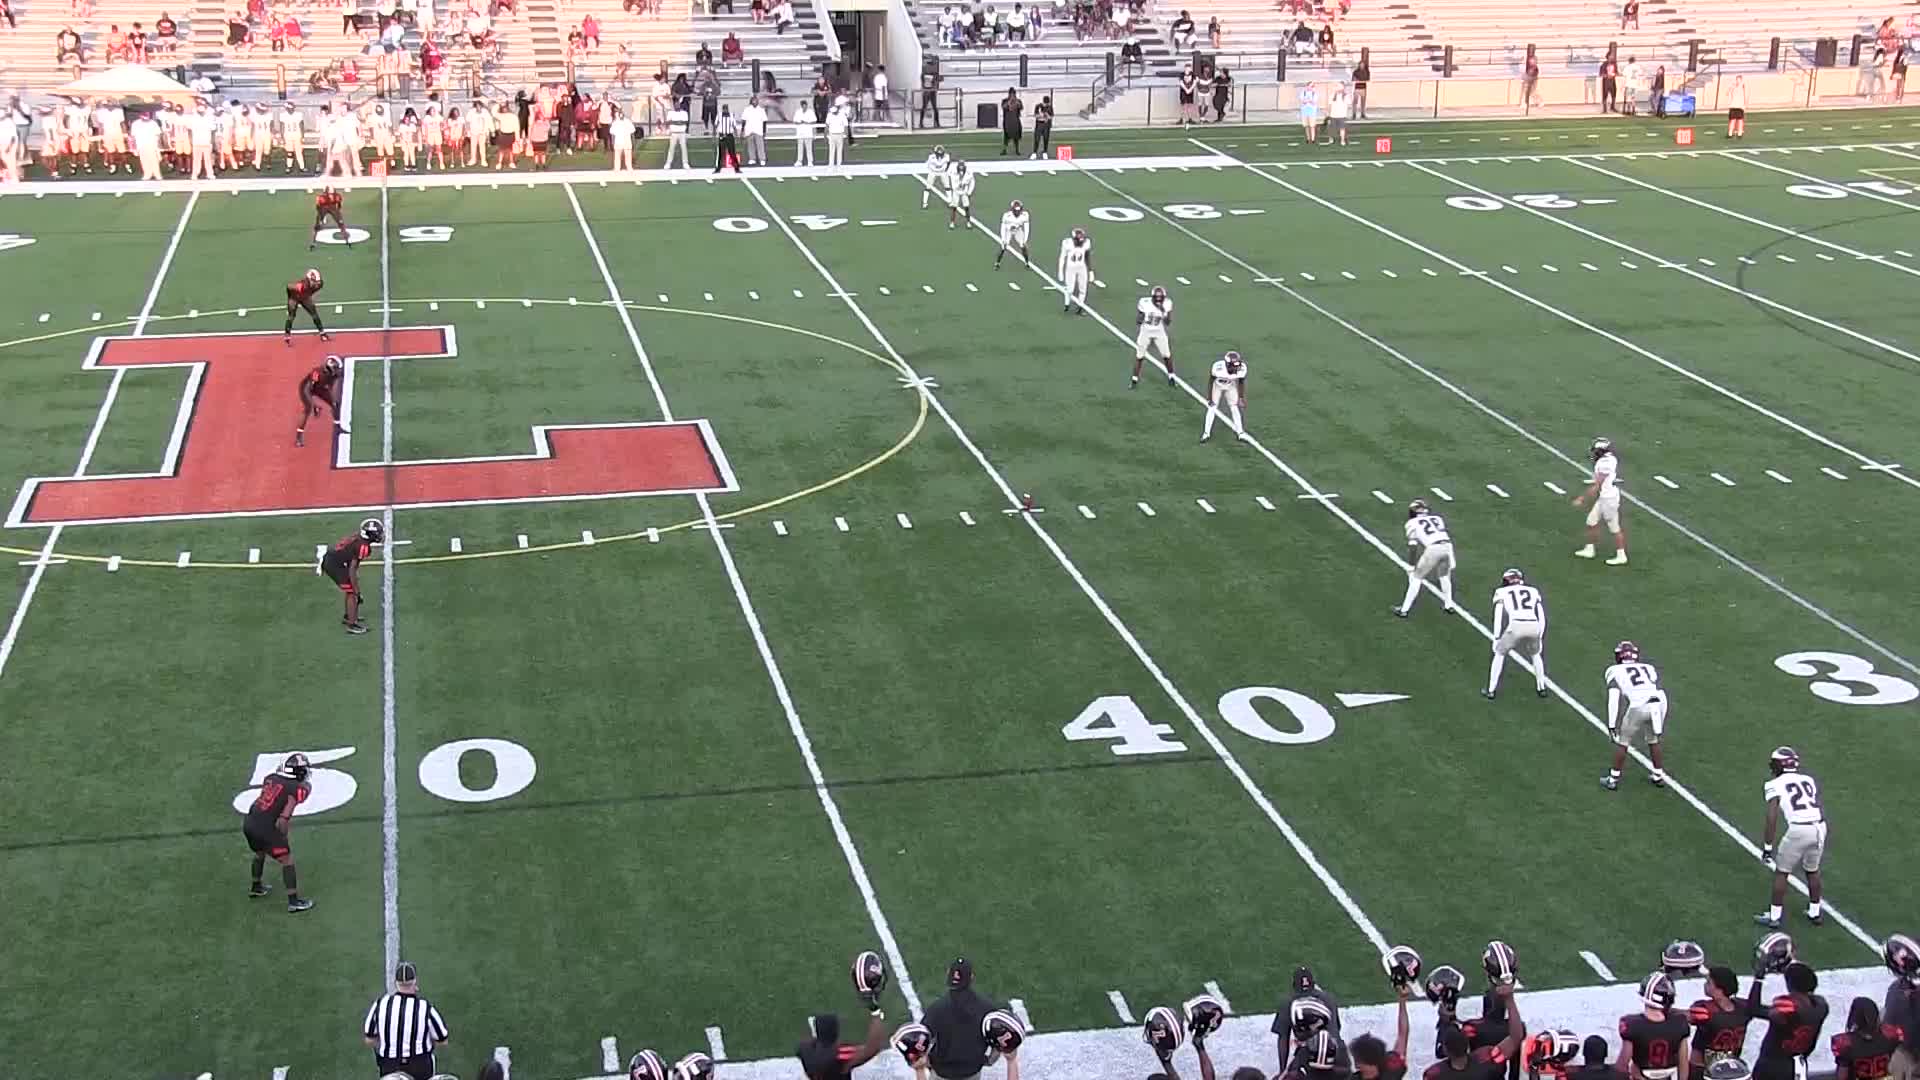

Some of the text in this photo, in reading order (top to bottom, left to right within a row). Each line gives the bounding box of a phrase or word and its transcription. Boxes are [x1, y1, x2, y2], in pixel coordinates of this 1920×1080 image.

[1508, 589, 1533, 611] 12
[1626, 666, 1654, 687] 21
[1062, 687, 1336, 755] 40
[233, 739, 537, 816] 50
[1786, 781, 1818, 811] 29
